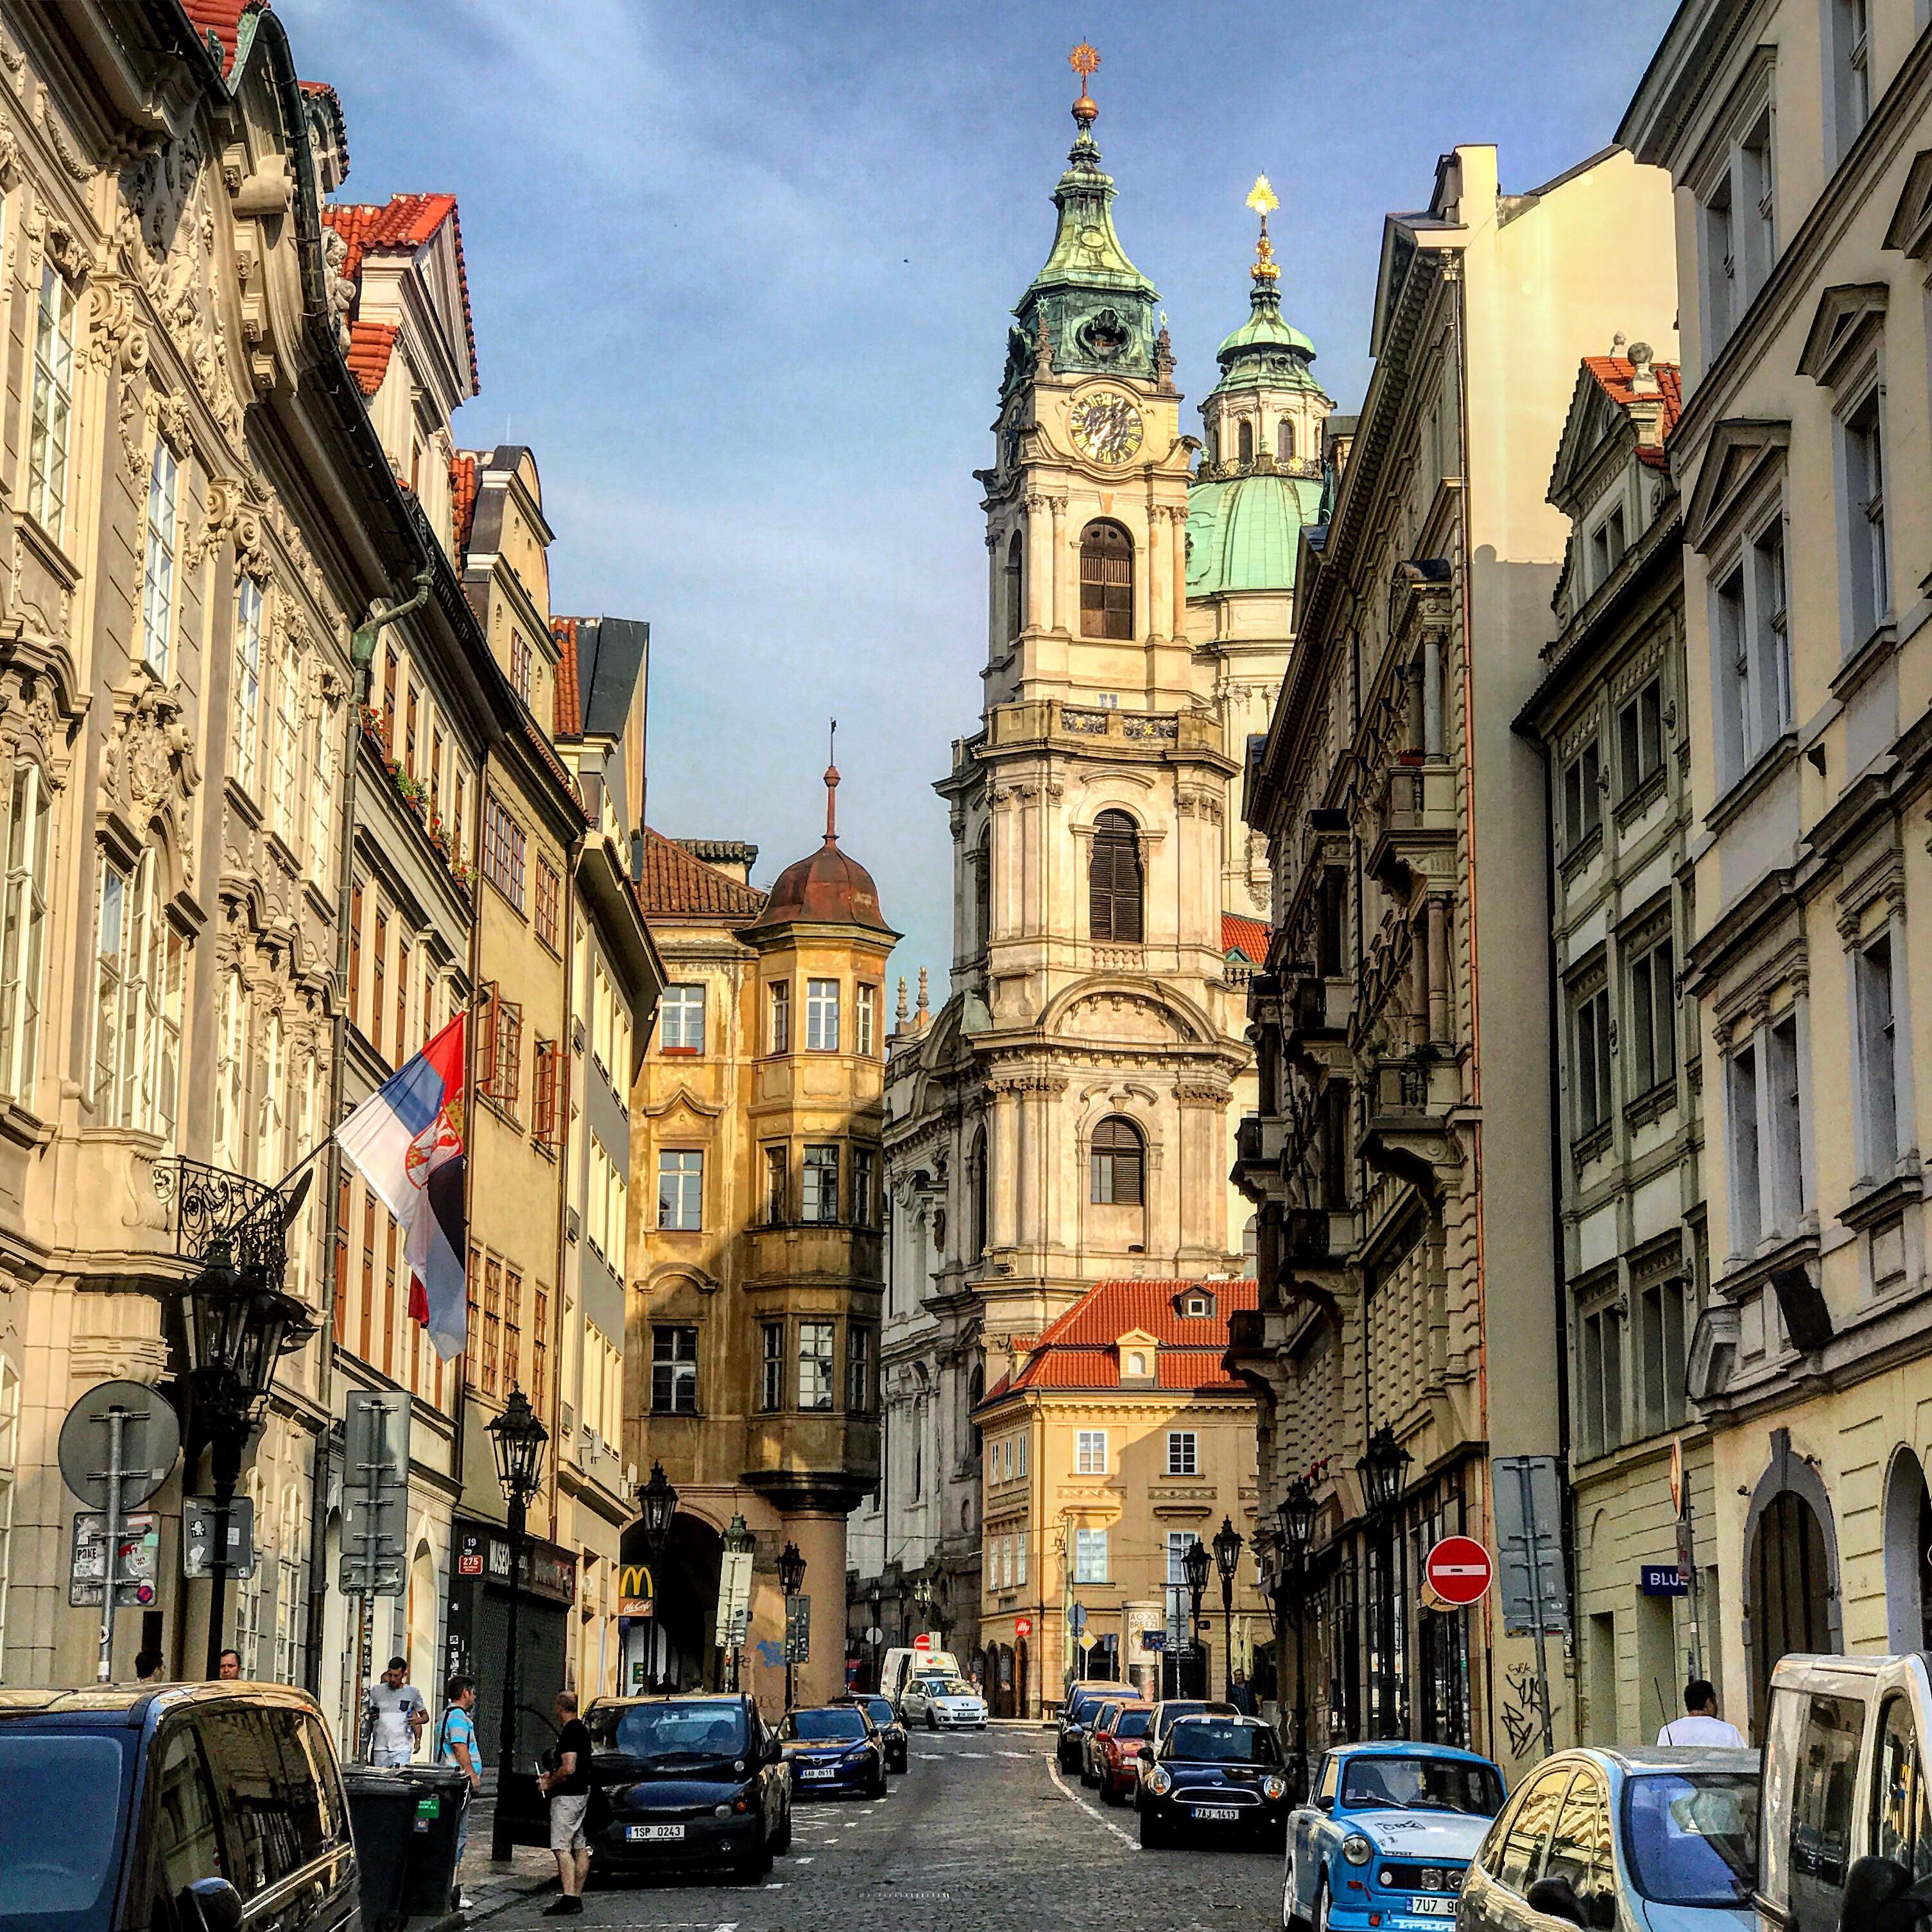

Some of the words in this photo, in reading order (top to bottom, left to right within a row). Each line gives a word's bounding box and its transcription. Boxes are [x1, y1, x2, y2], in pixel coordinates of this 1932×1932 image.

[468, 1538, 476, 1546] 19
[463, 1557, 479, 1565] 275
[1197, 1809, 1212, 1818] 7AJ
[1217, 1810, 1236, 1819] 1413
[634, 1827, 651, 1837] 1SP
[657, 1826, 680, 1836] 0243
[1415, 1899, 1438, 1912] 7U7
